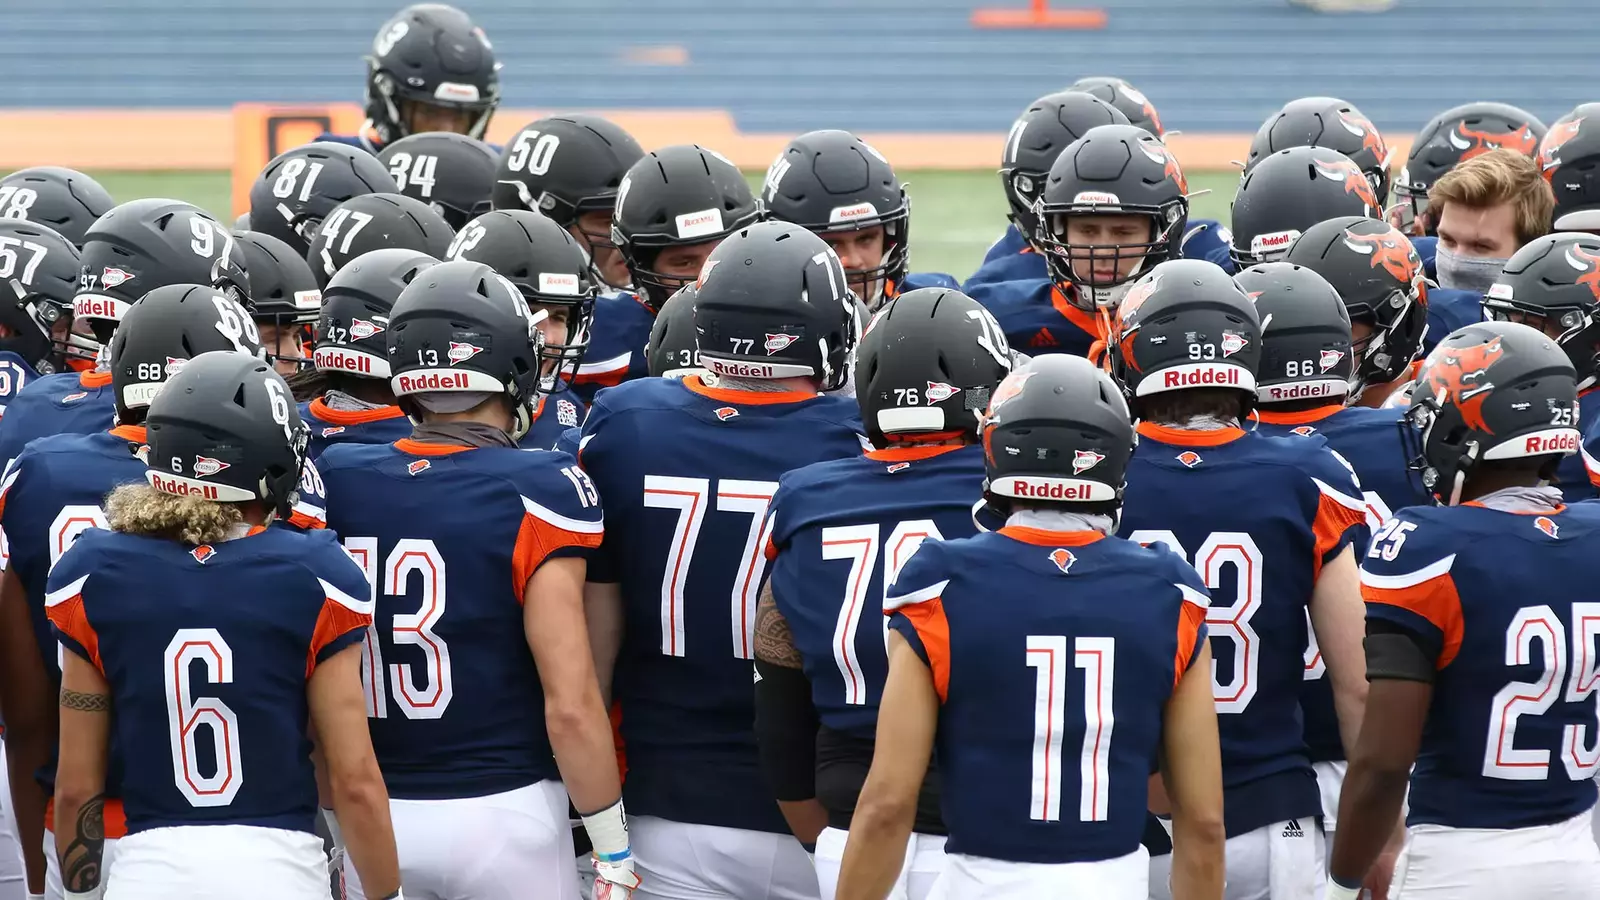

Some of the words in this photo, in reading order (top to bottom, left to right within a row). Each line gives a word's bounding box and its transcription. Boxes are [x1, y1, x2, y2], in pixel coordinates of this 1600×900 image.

[508, 130, 559, 176] 50
[273, 159, 324, 202] 81
[389, 153, 438, 197] 34
[321, 208, 373, 255] 47
[1262, 234, 1289, 246] Riddell
[189, 217, 233, 271] 97
[0, 236, 48, 286] 57
[80, 274, 98, 291] 97
[327, 326, 347, 345] 42
[730, 337, 754, 354] 77
[417, 349, 439, 367] 13
[1189, 343, 1216, 360] 93
[138, 363, 161, 380] 68
[315, 352, 371, 373] Riddell
[714, 361, 773, 377] Riddell
[1286, 360, 1314, 378] 86
[400, 373, 469, 392] Riddell
[1164, 368, 1239, 388] Riddell
[264, 378, 290, 425] 6
[894, 388, 919, 406] 76
[1550, 407, 1572, 426] 25
[171, 457, 183, 473] 6
[560, 465, 599, 508] 13
[1014, 480, 1092, 499] Riddell
[1367, 518, 1417, 562] 25
[644, 475, 785, 660] 77
[345, 537, 453, 719] 13
[1482, 602, 1600, 781] 25
[164, 628, 243, 807] 6
[1026, 635, 1115, 822] 11
